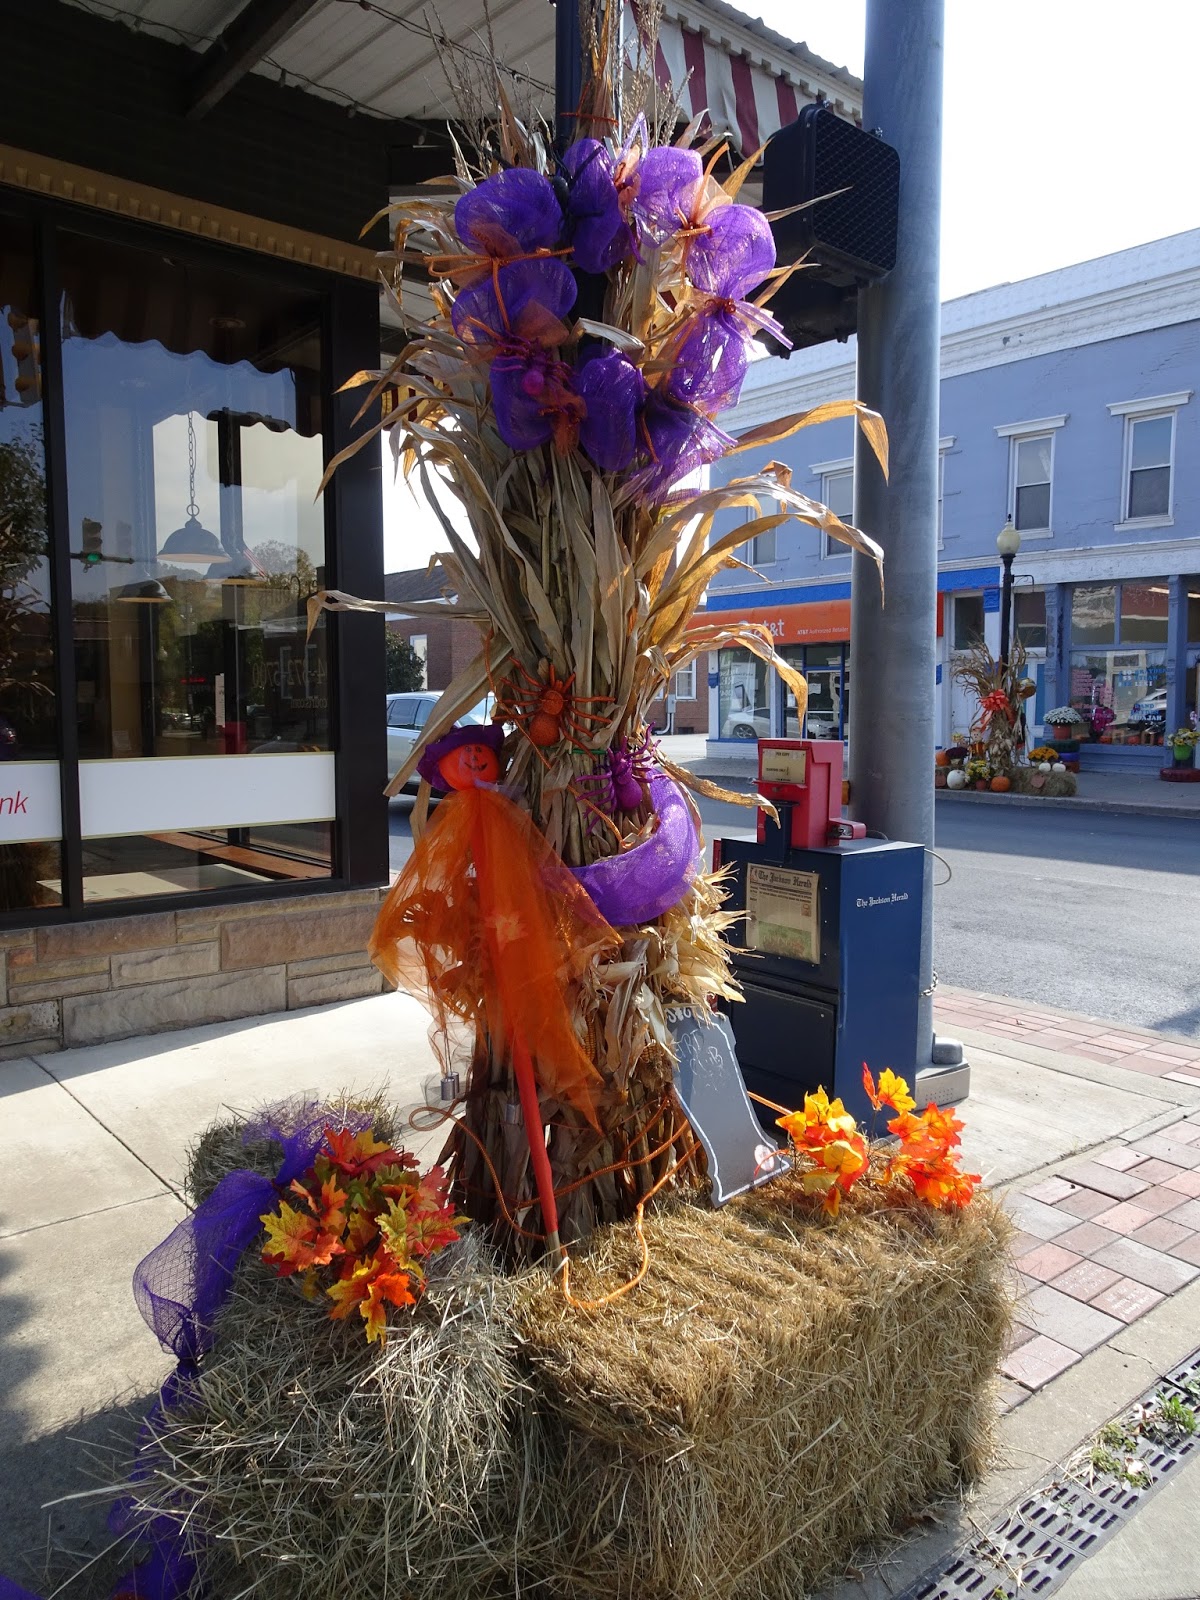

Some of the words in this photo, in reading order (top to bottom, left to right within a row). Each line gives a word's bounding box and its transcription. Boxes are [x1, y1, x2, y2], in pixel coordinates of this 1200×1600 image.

[0, 790, 29, 815] nk
[758, 869, 769, 882] The
[769, 872, 792, 885] Jackson
[792, 876, 813, 889] Herald
[856, 898, 868, 909] The
[868, 896, 891, 907] Jackson
[891, 892, 909, 905] Herald
